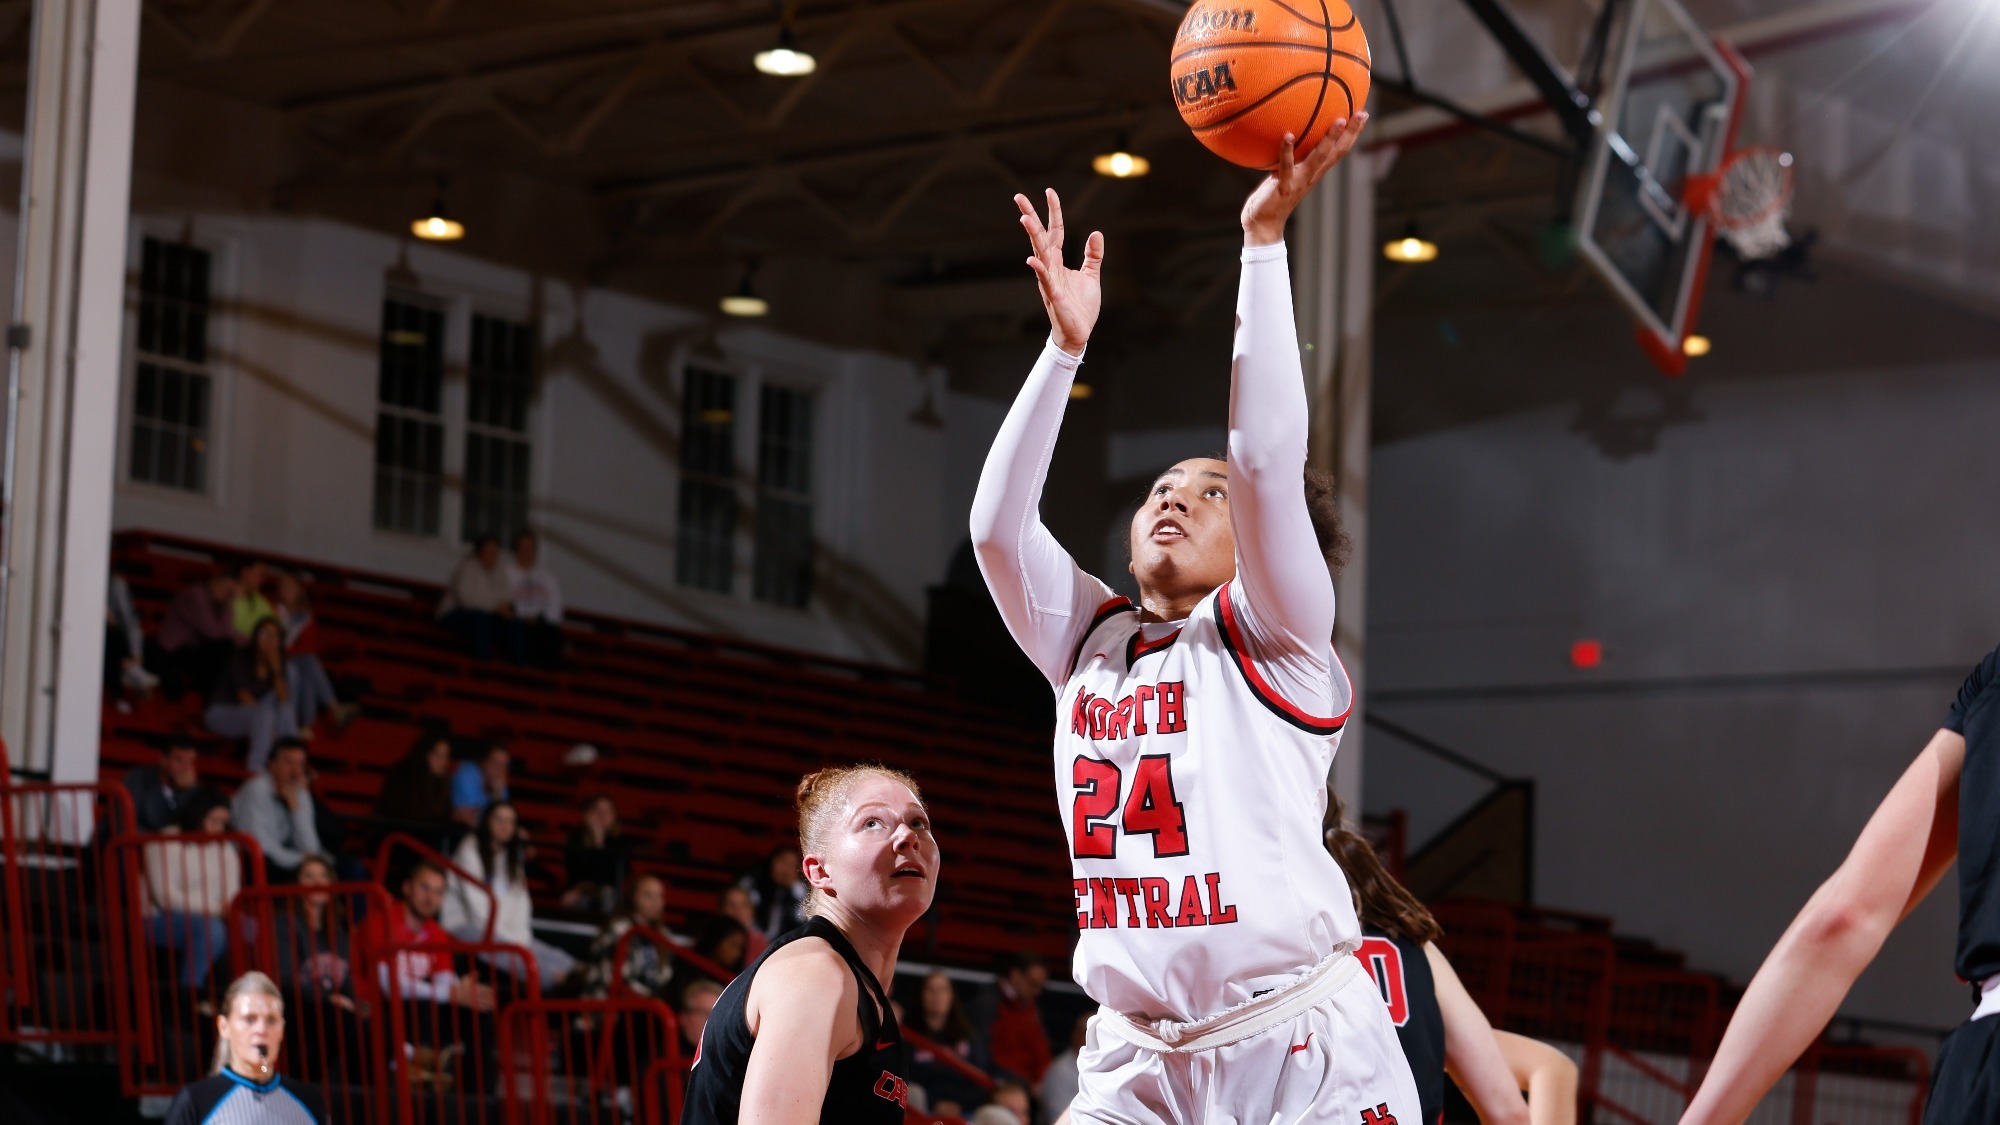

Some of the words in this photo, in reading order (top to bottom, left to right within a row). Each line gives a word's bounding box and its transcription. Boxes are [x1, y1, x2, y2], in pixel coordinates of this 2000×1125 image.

[1173, 63, 1237, 105] NCAA
[1072, 680, 1187, 740] NORTH
[1073, 753, 1190, 859] 24
[1073, 872, 1238, 929] ENTRAL
